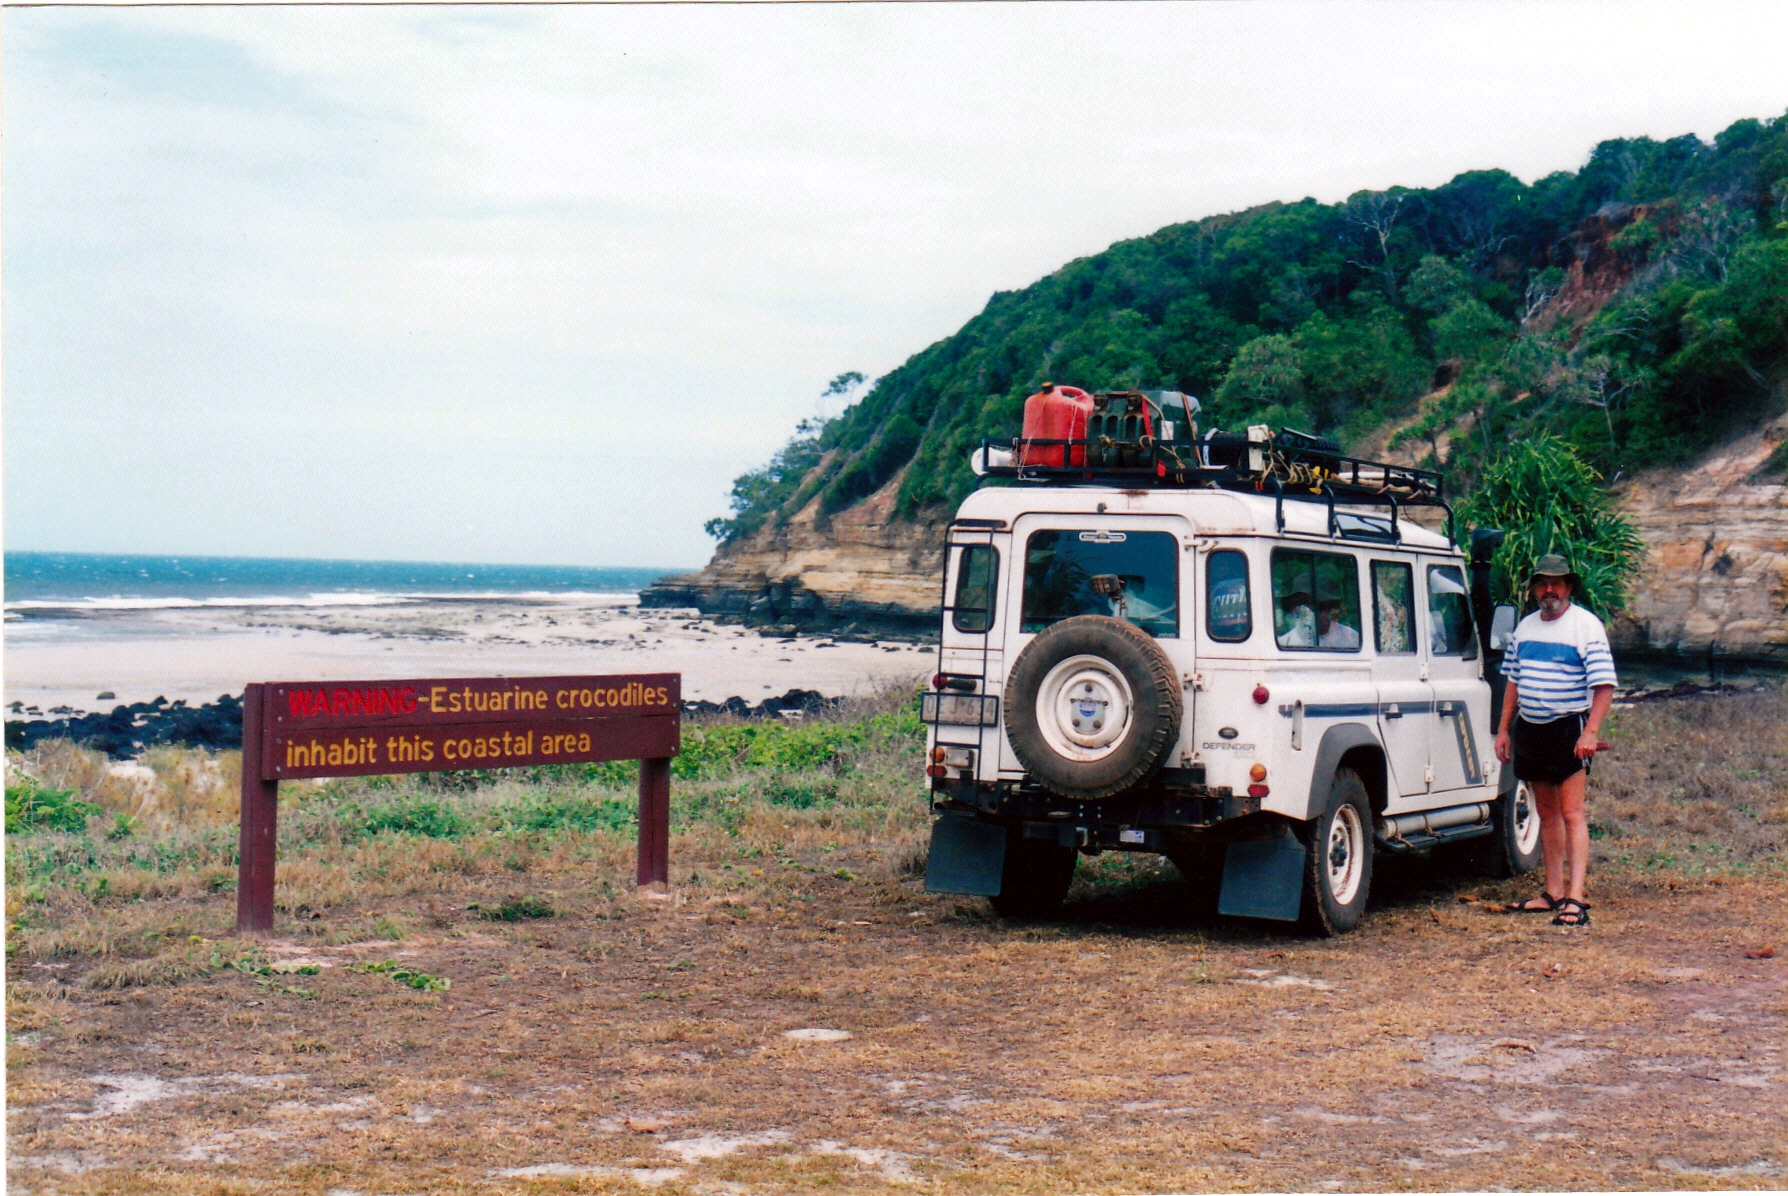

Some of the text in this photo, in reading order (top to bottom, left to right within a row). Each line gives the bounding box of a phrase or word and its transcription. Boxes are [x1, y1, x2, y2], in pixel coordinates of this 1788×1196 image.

[555, 681, 669, 709] crocodiles
[286, 729, 592, 768] inhabit this coastal area
[1202, 742, 1257, 751] DEFENDER
